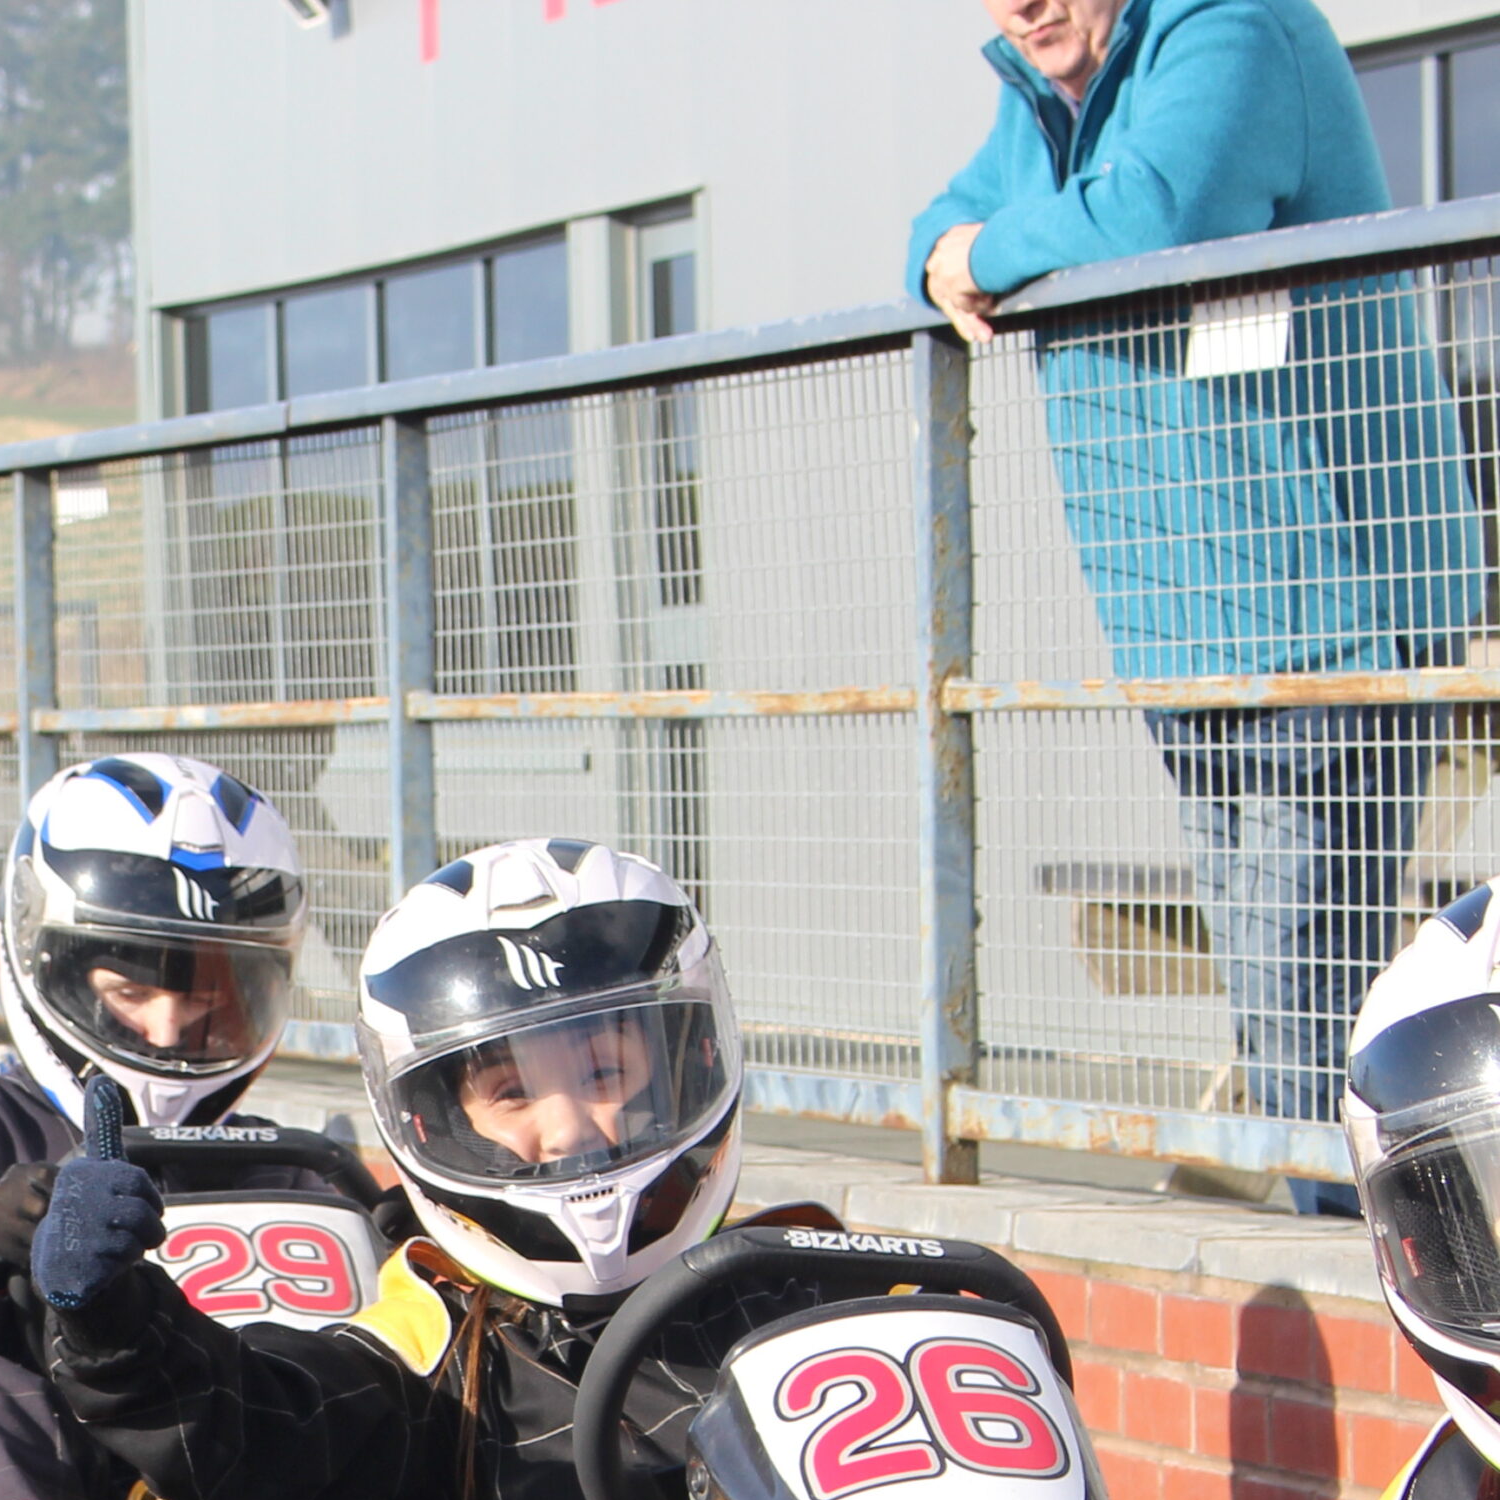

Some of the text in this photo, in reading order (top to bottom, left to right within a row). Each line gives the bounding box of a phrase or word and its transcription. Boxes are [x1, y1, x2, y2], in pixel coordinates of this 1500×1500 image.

[153, 1126, 279, 1142] BIZKARTS
[784, 1229, 945, 1258] BIZKARTS
[157, 1220, 363, 1318] 29
